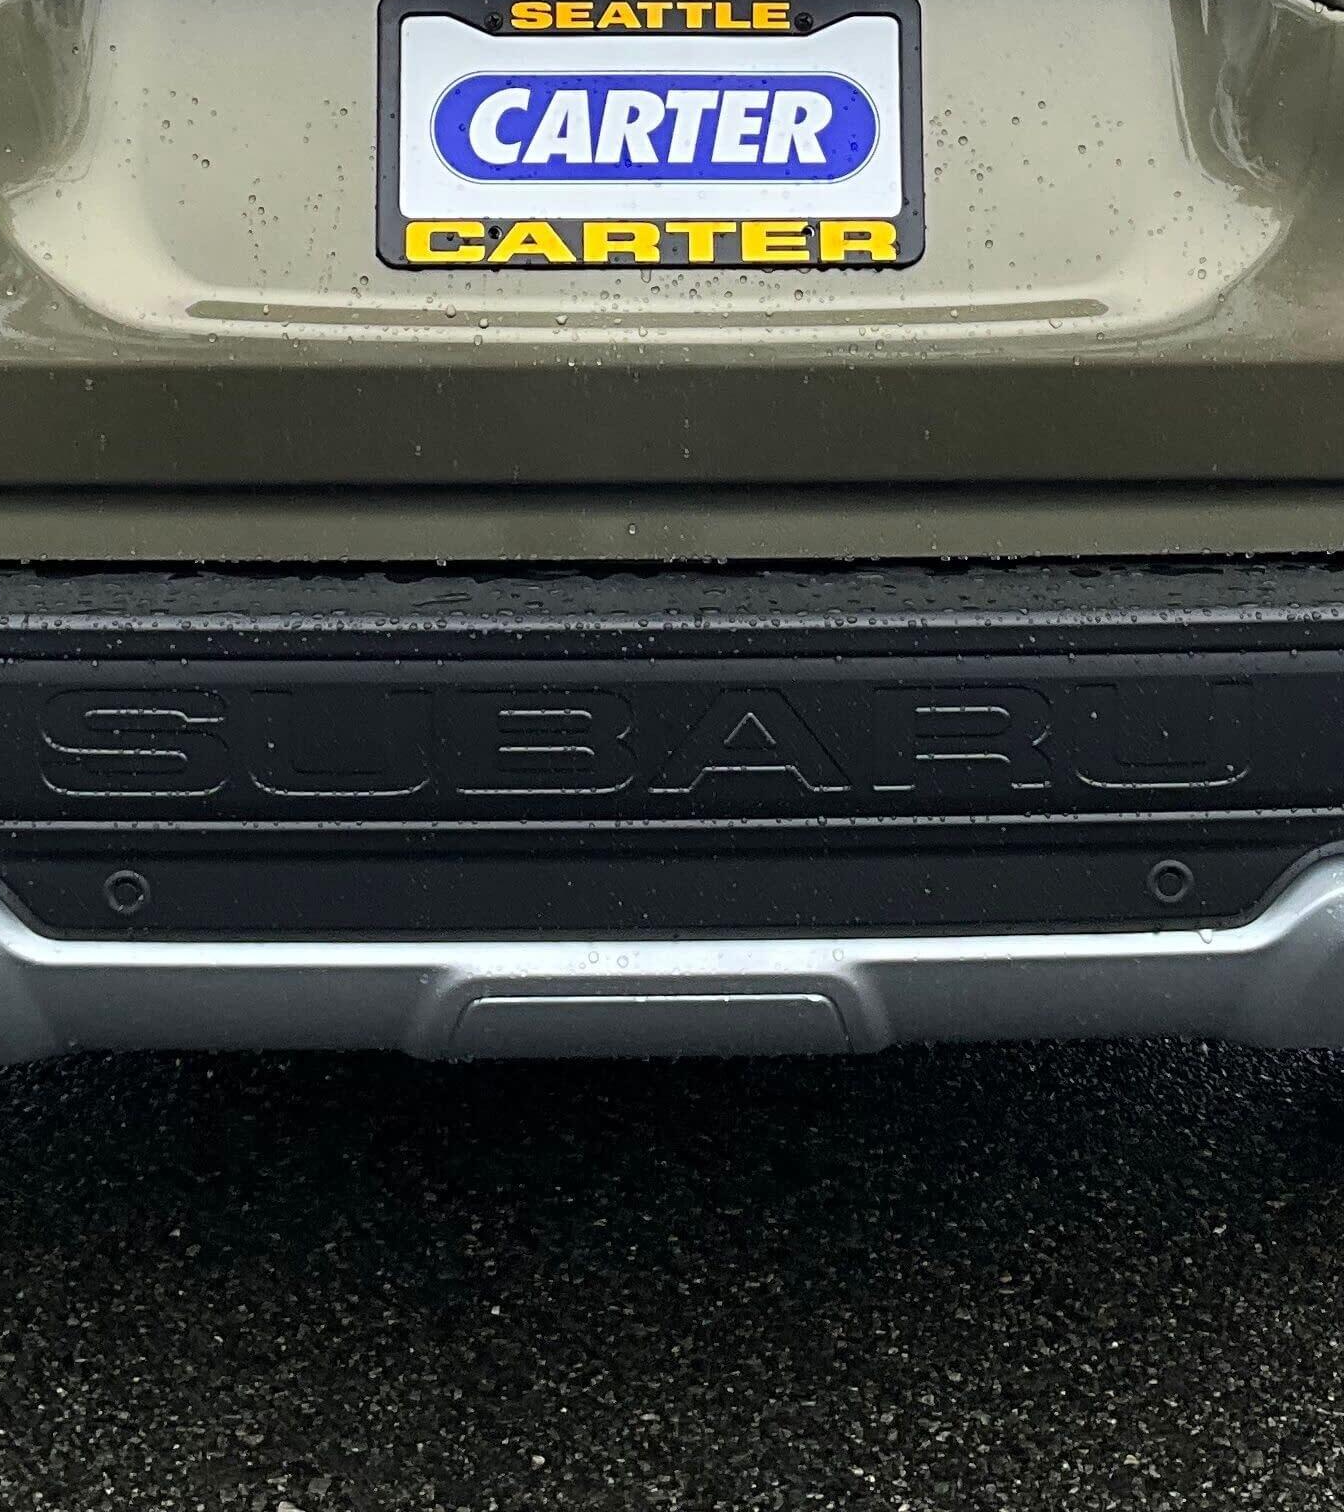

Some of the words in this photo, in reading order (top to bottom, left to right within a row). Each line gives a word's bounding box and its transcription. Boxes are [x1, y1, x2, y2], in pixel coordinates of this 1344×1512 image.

[510, 0, 791, 30] SEATTLE
[468, 86, 834, 165] CARTER
[404, 219, 898, 264] CARTER
[41, 682, 1254, 796] SUBARU
